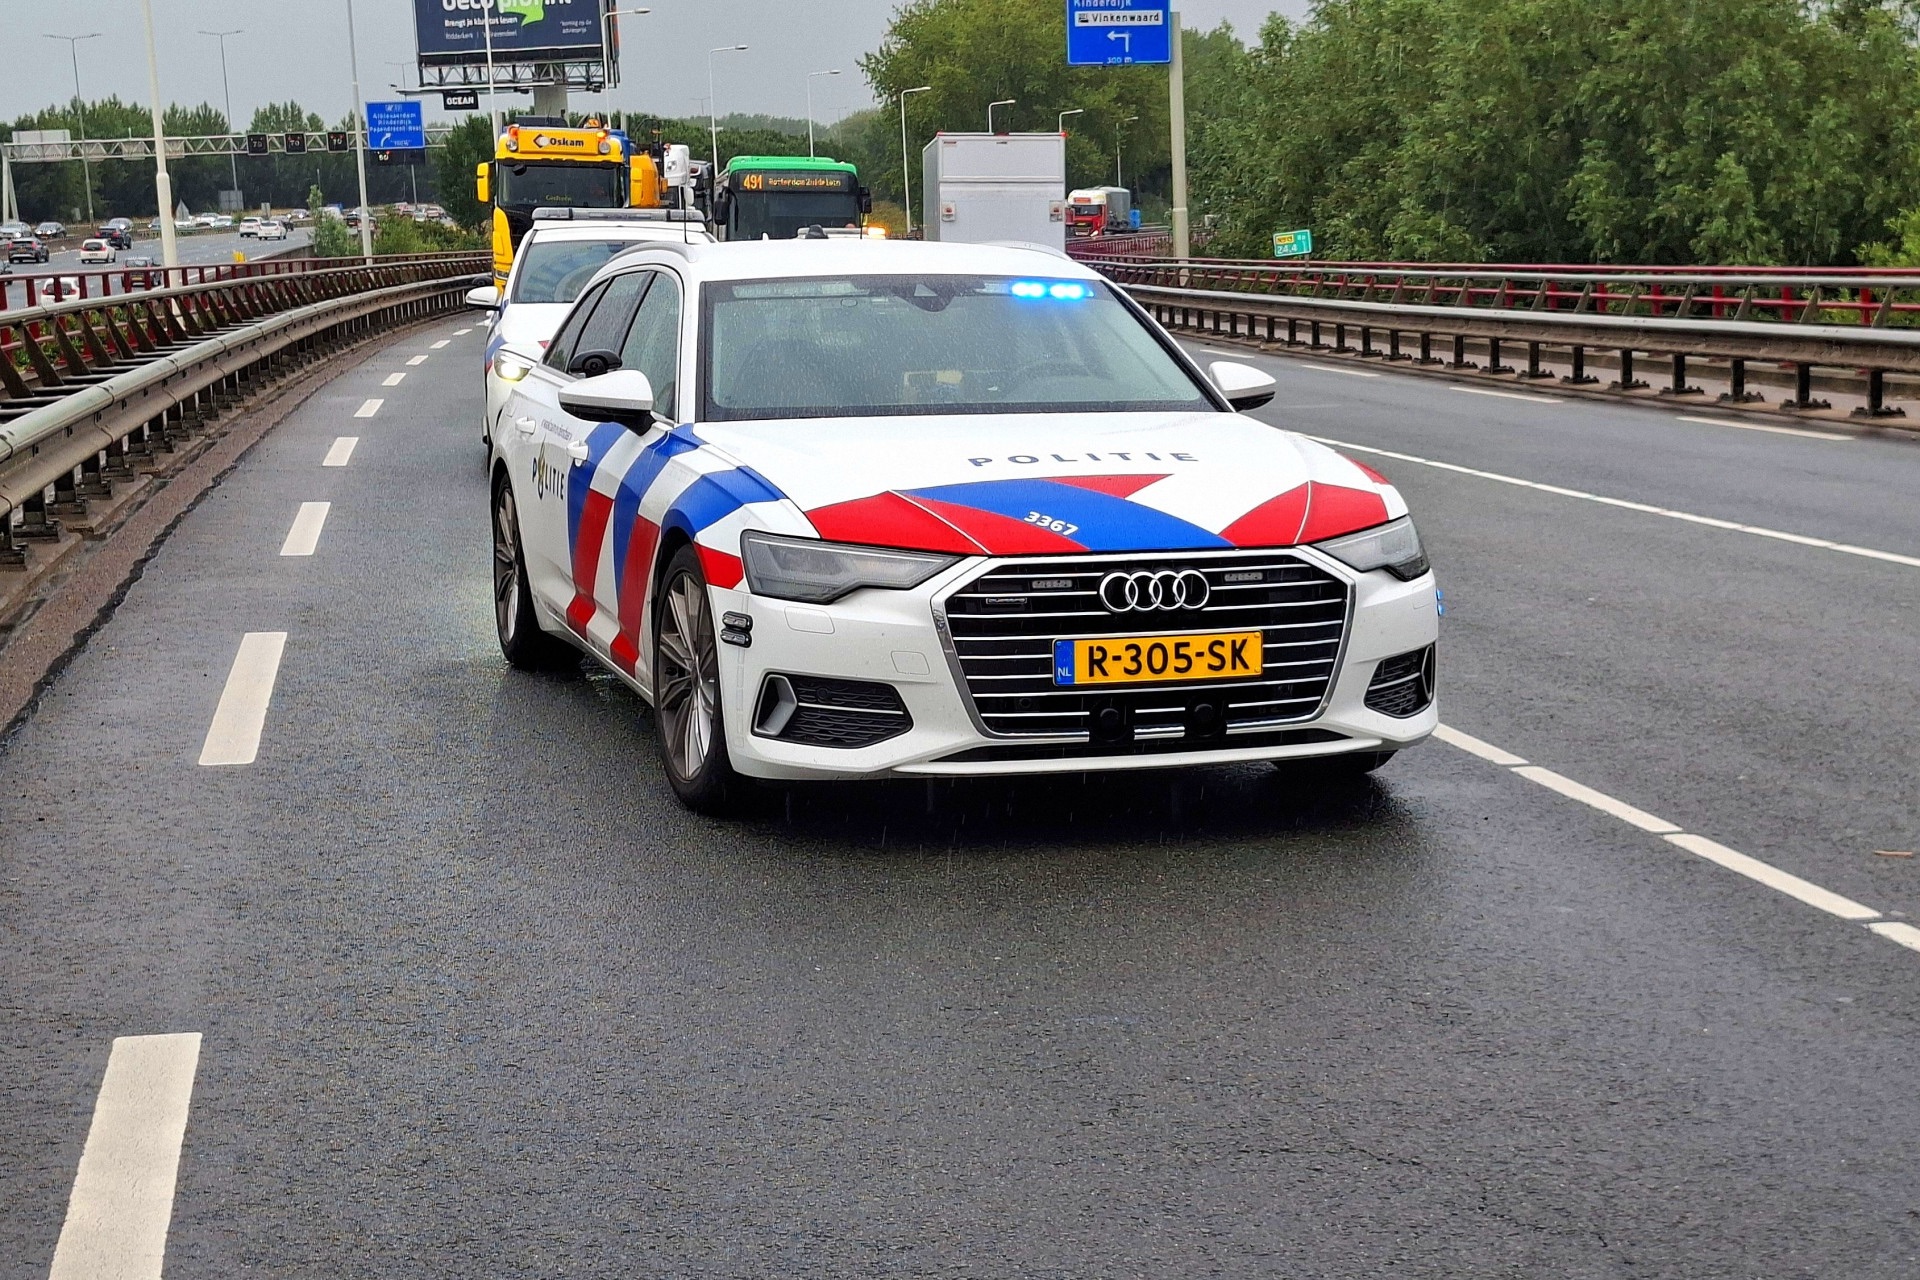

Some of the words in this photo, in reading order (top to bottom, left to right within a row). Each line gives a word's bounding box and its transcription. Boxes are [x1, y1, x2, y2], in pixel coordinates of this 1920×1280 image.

[1092, 13, 1159, 22] Vinkenwaard
[446, 96, 474, 105] OCEAN
[549, 137, 584, 147] Oskam
[743, 174, 763, 190] 491
[967, 452, 1199, 467] POLITIE
[1024, 511, 1079, 536] 3367
[1087, 637, 1250, 679] R-305-SK
[1057, 666, 1072, 679] NL
